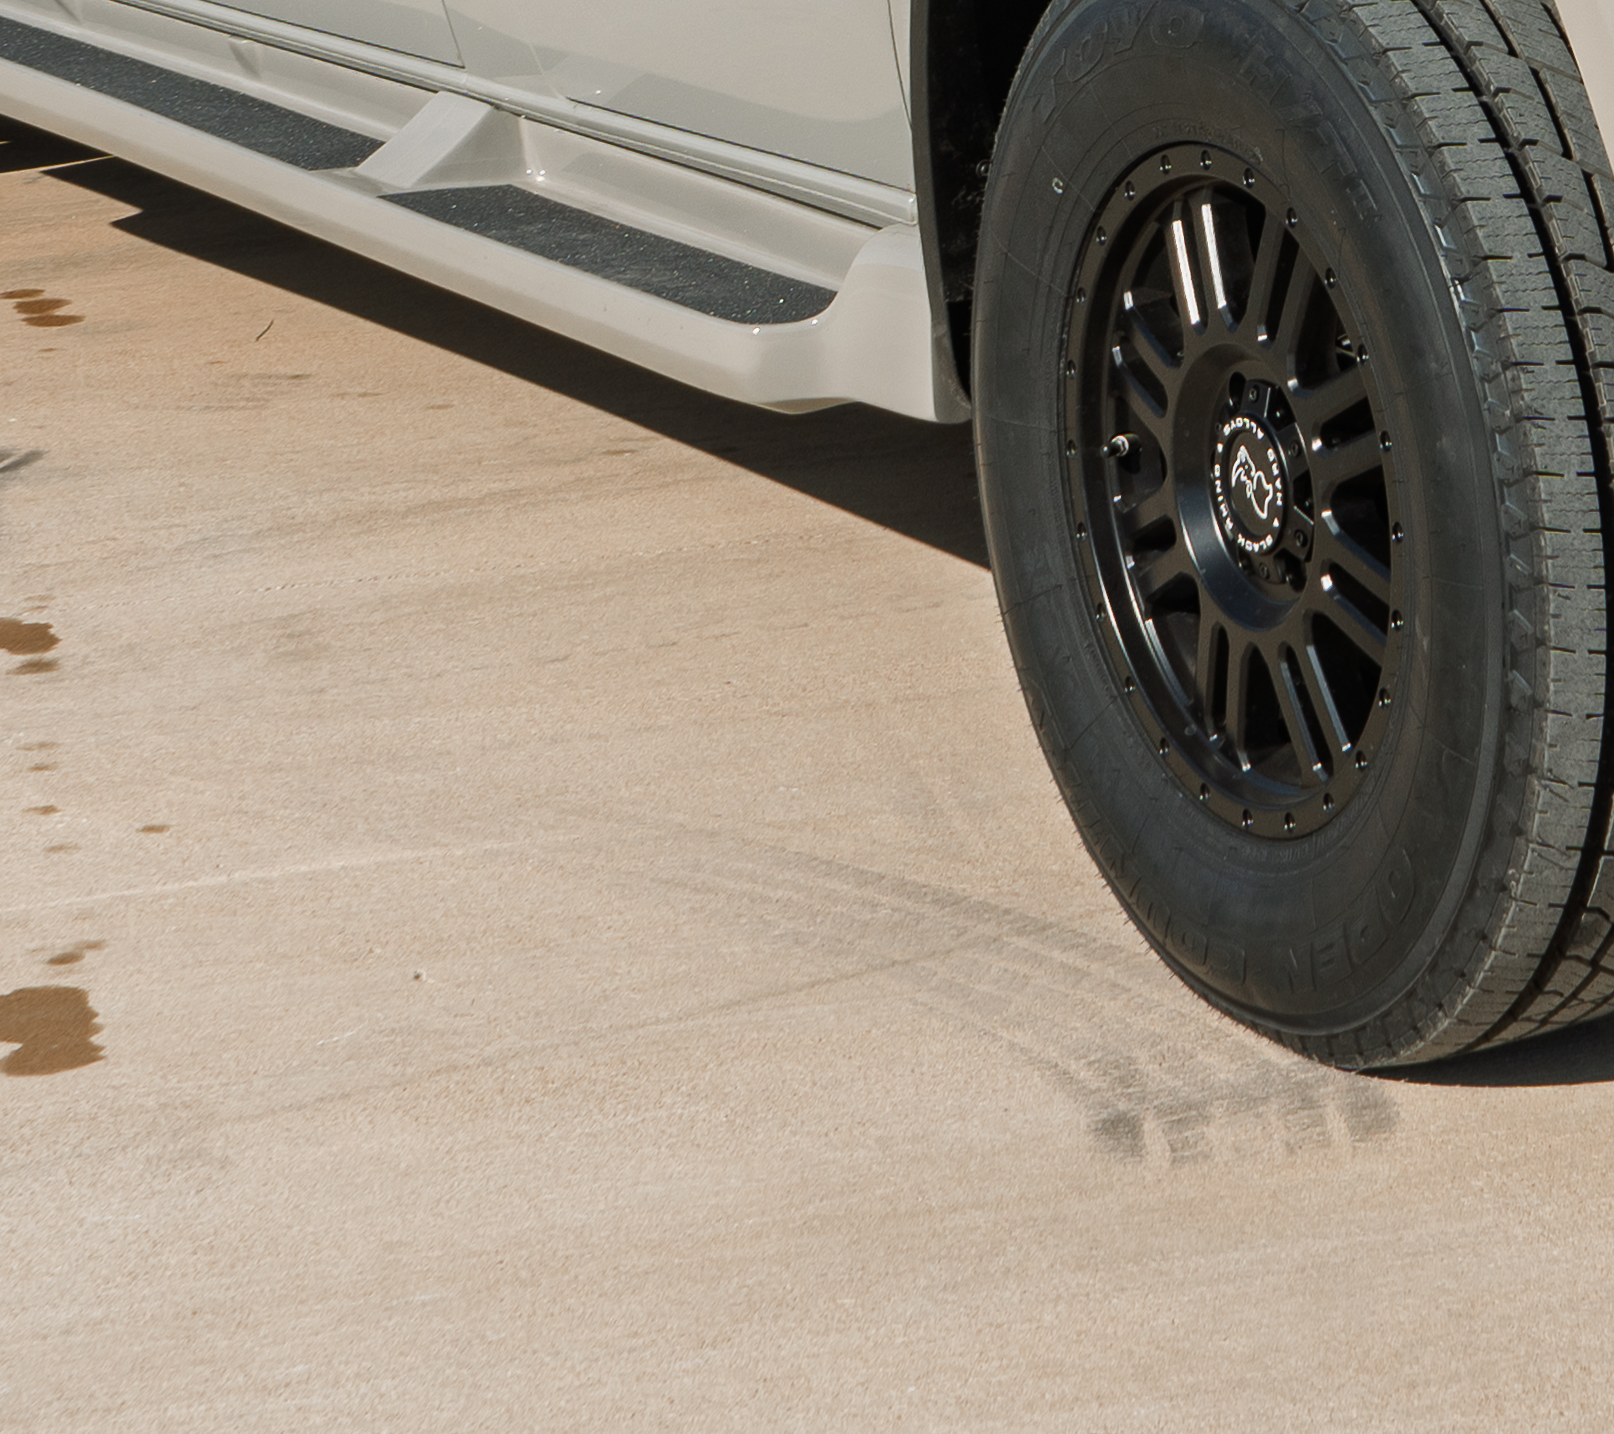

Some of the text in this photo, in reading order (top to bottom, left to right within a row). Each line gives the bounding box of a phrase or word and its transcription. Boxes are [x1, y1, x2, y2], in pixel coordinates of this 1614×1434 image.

[1223, 417, 1283, 506] HARD ALLOYS
[1214, 463, 1274, 553] BLACK RHINO
